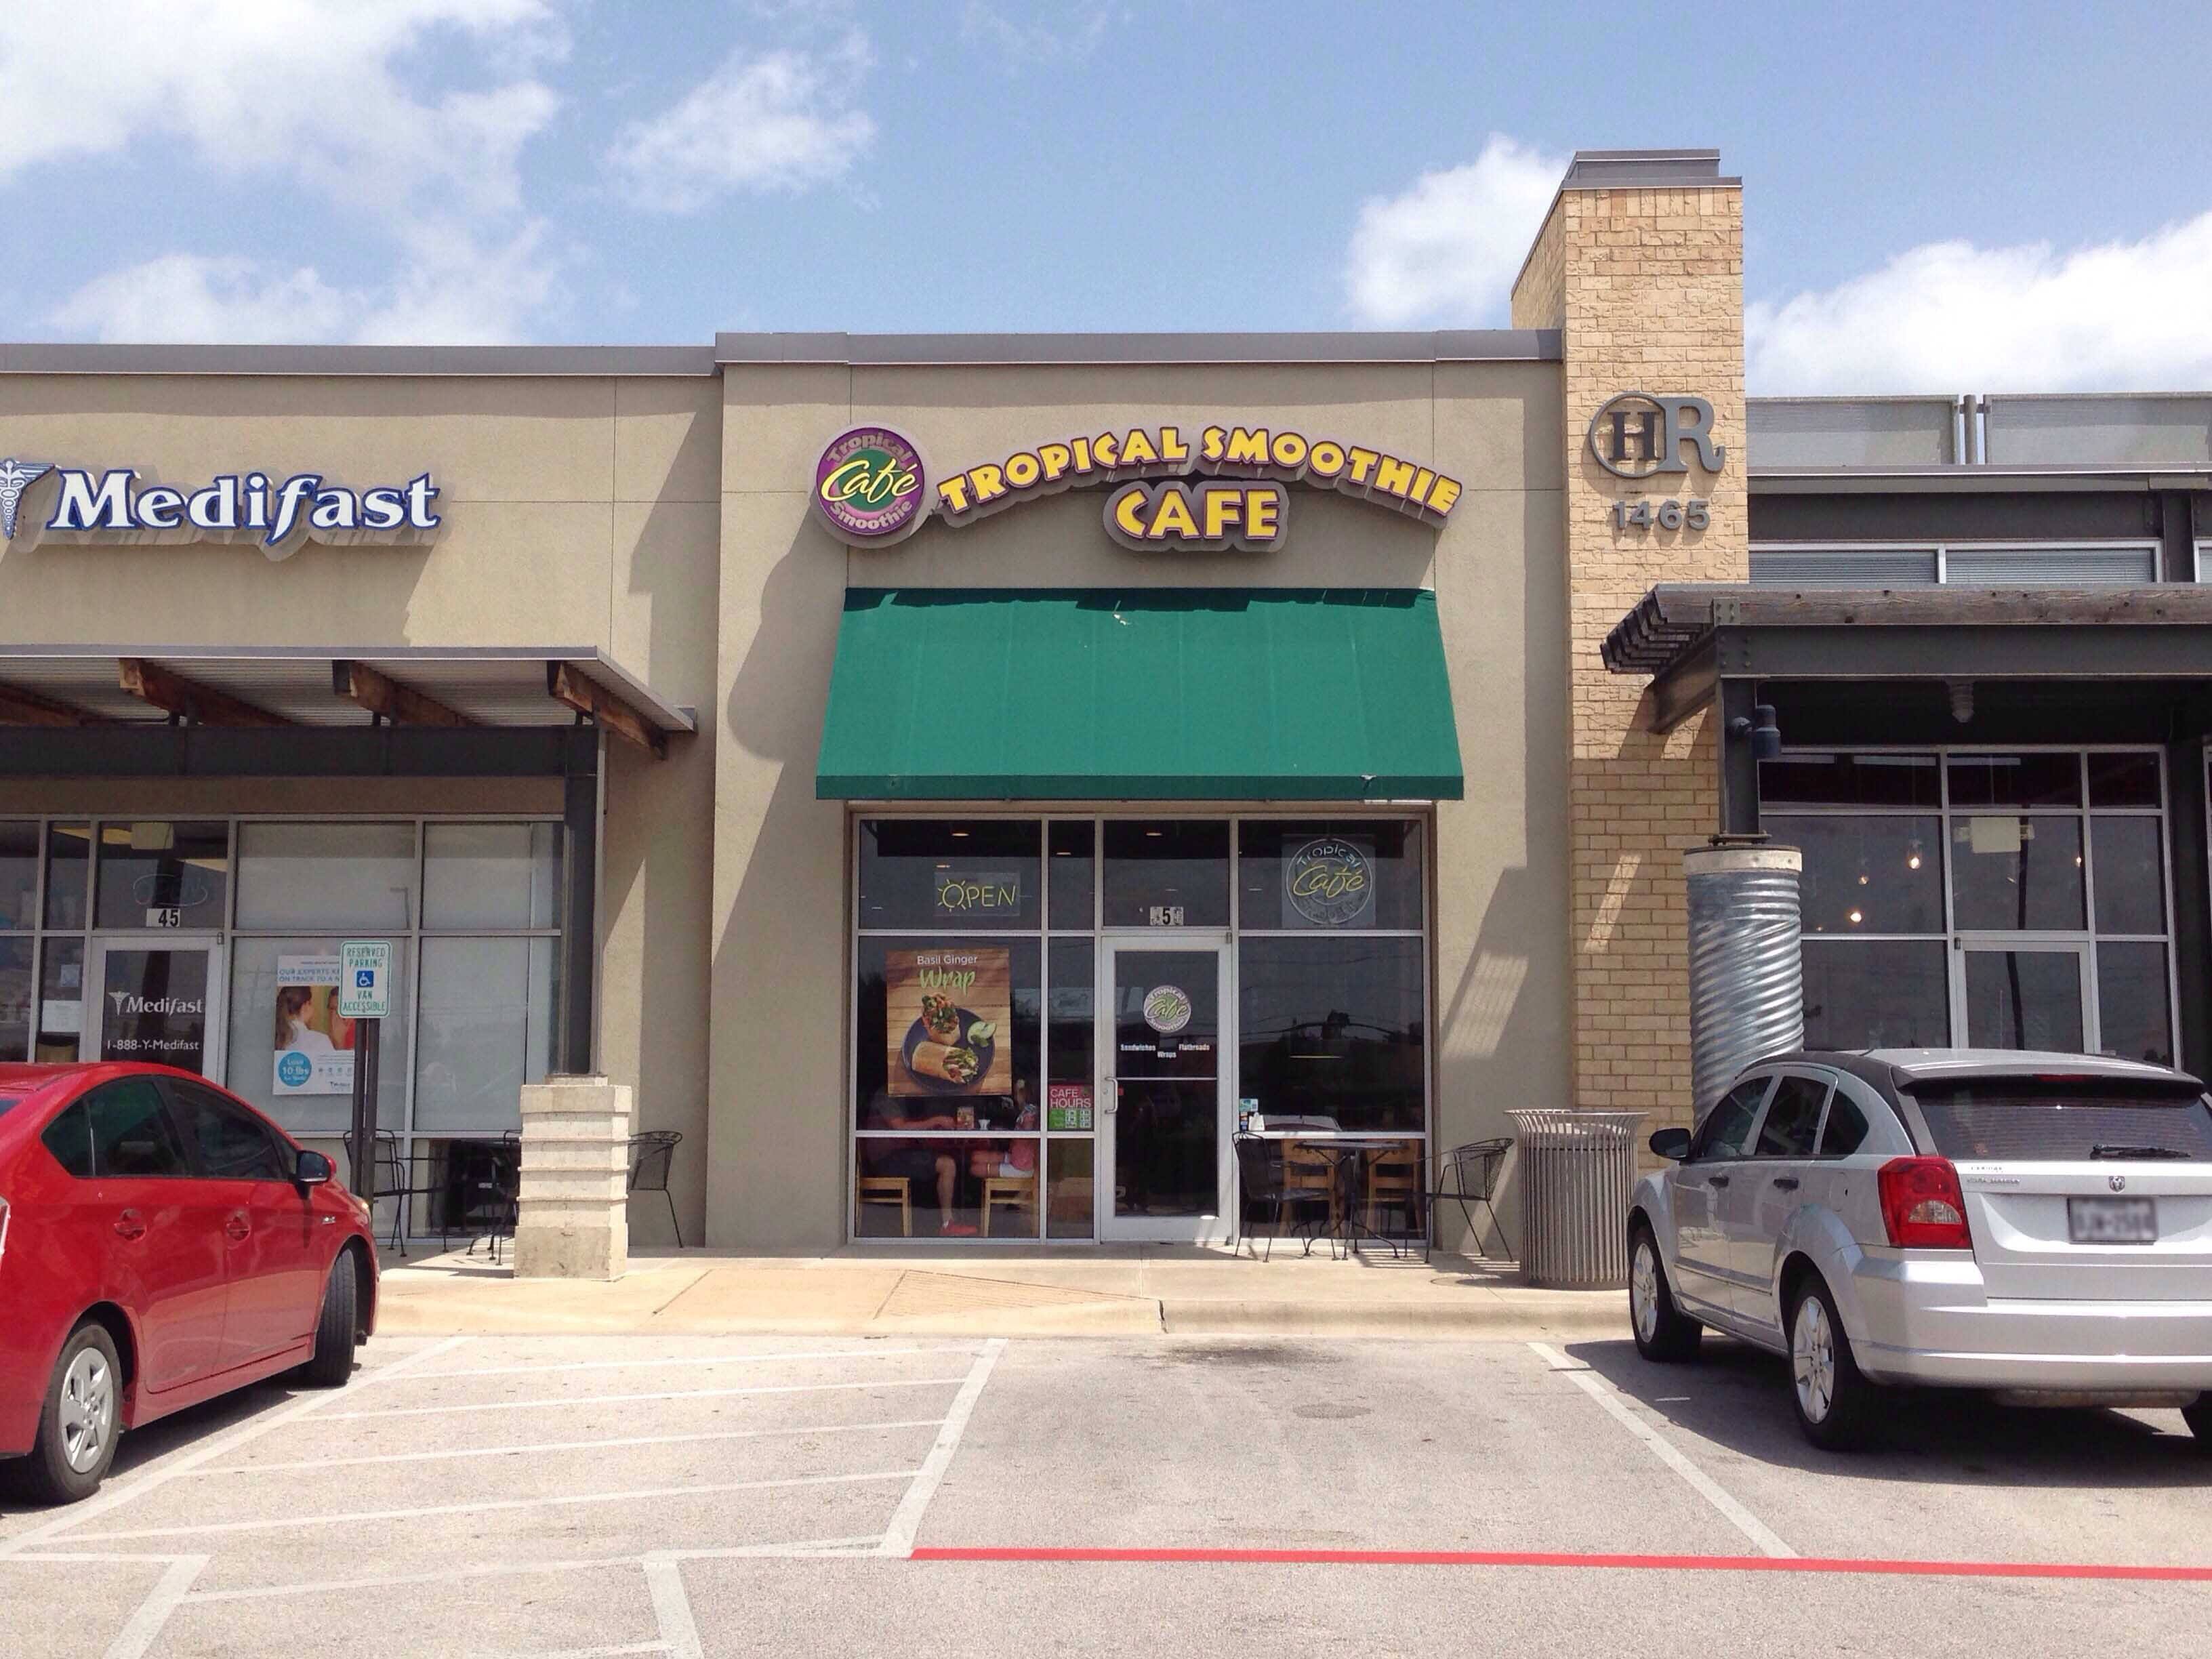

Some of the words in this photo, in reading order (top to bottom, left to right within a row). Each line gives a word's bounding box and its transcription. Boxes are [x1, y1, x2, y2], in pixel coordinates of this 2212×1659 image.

[826, 432, 914, 464] Tropical
[821, 457, 919, 503] Café
[937, 426, 1189, 514] TROPICAL
[1201, 425, 1462, 516] SMOOTHIE
[46, 469, 442, 546] Medifast
[830, 500, 913, 529] Smoothie
[1115, 489, 1279, 540] CAFE
[1612, 499, 1710, 530] 1465
[1296, 844, 1361, 867] Tropical
[1293, 864, 1365, 898] Café
[940, 881, 1016, 909] OPEN
[158, 909, 179, 927] 45
[346, 947, 386, 957] RESERVED
[349, 958, 383, 968] PARKING
[917, 955, 941, 965] Basil
[943, 954, 978, 966] Ginger
[920, 966, 975, 997] Wrap
[126, 996, 203, 1017] Medifast
[343, 1001, 386, 1012] ACCESSIBLE
[357, 990, 373, 1000] VAN
[107, 1039, 199, 1050] 1-888-Y-Medifast
[1051, 1098, 1091, 1108] HOURS
